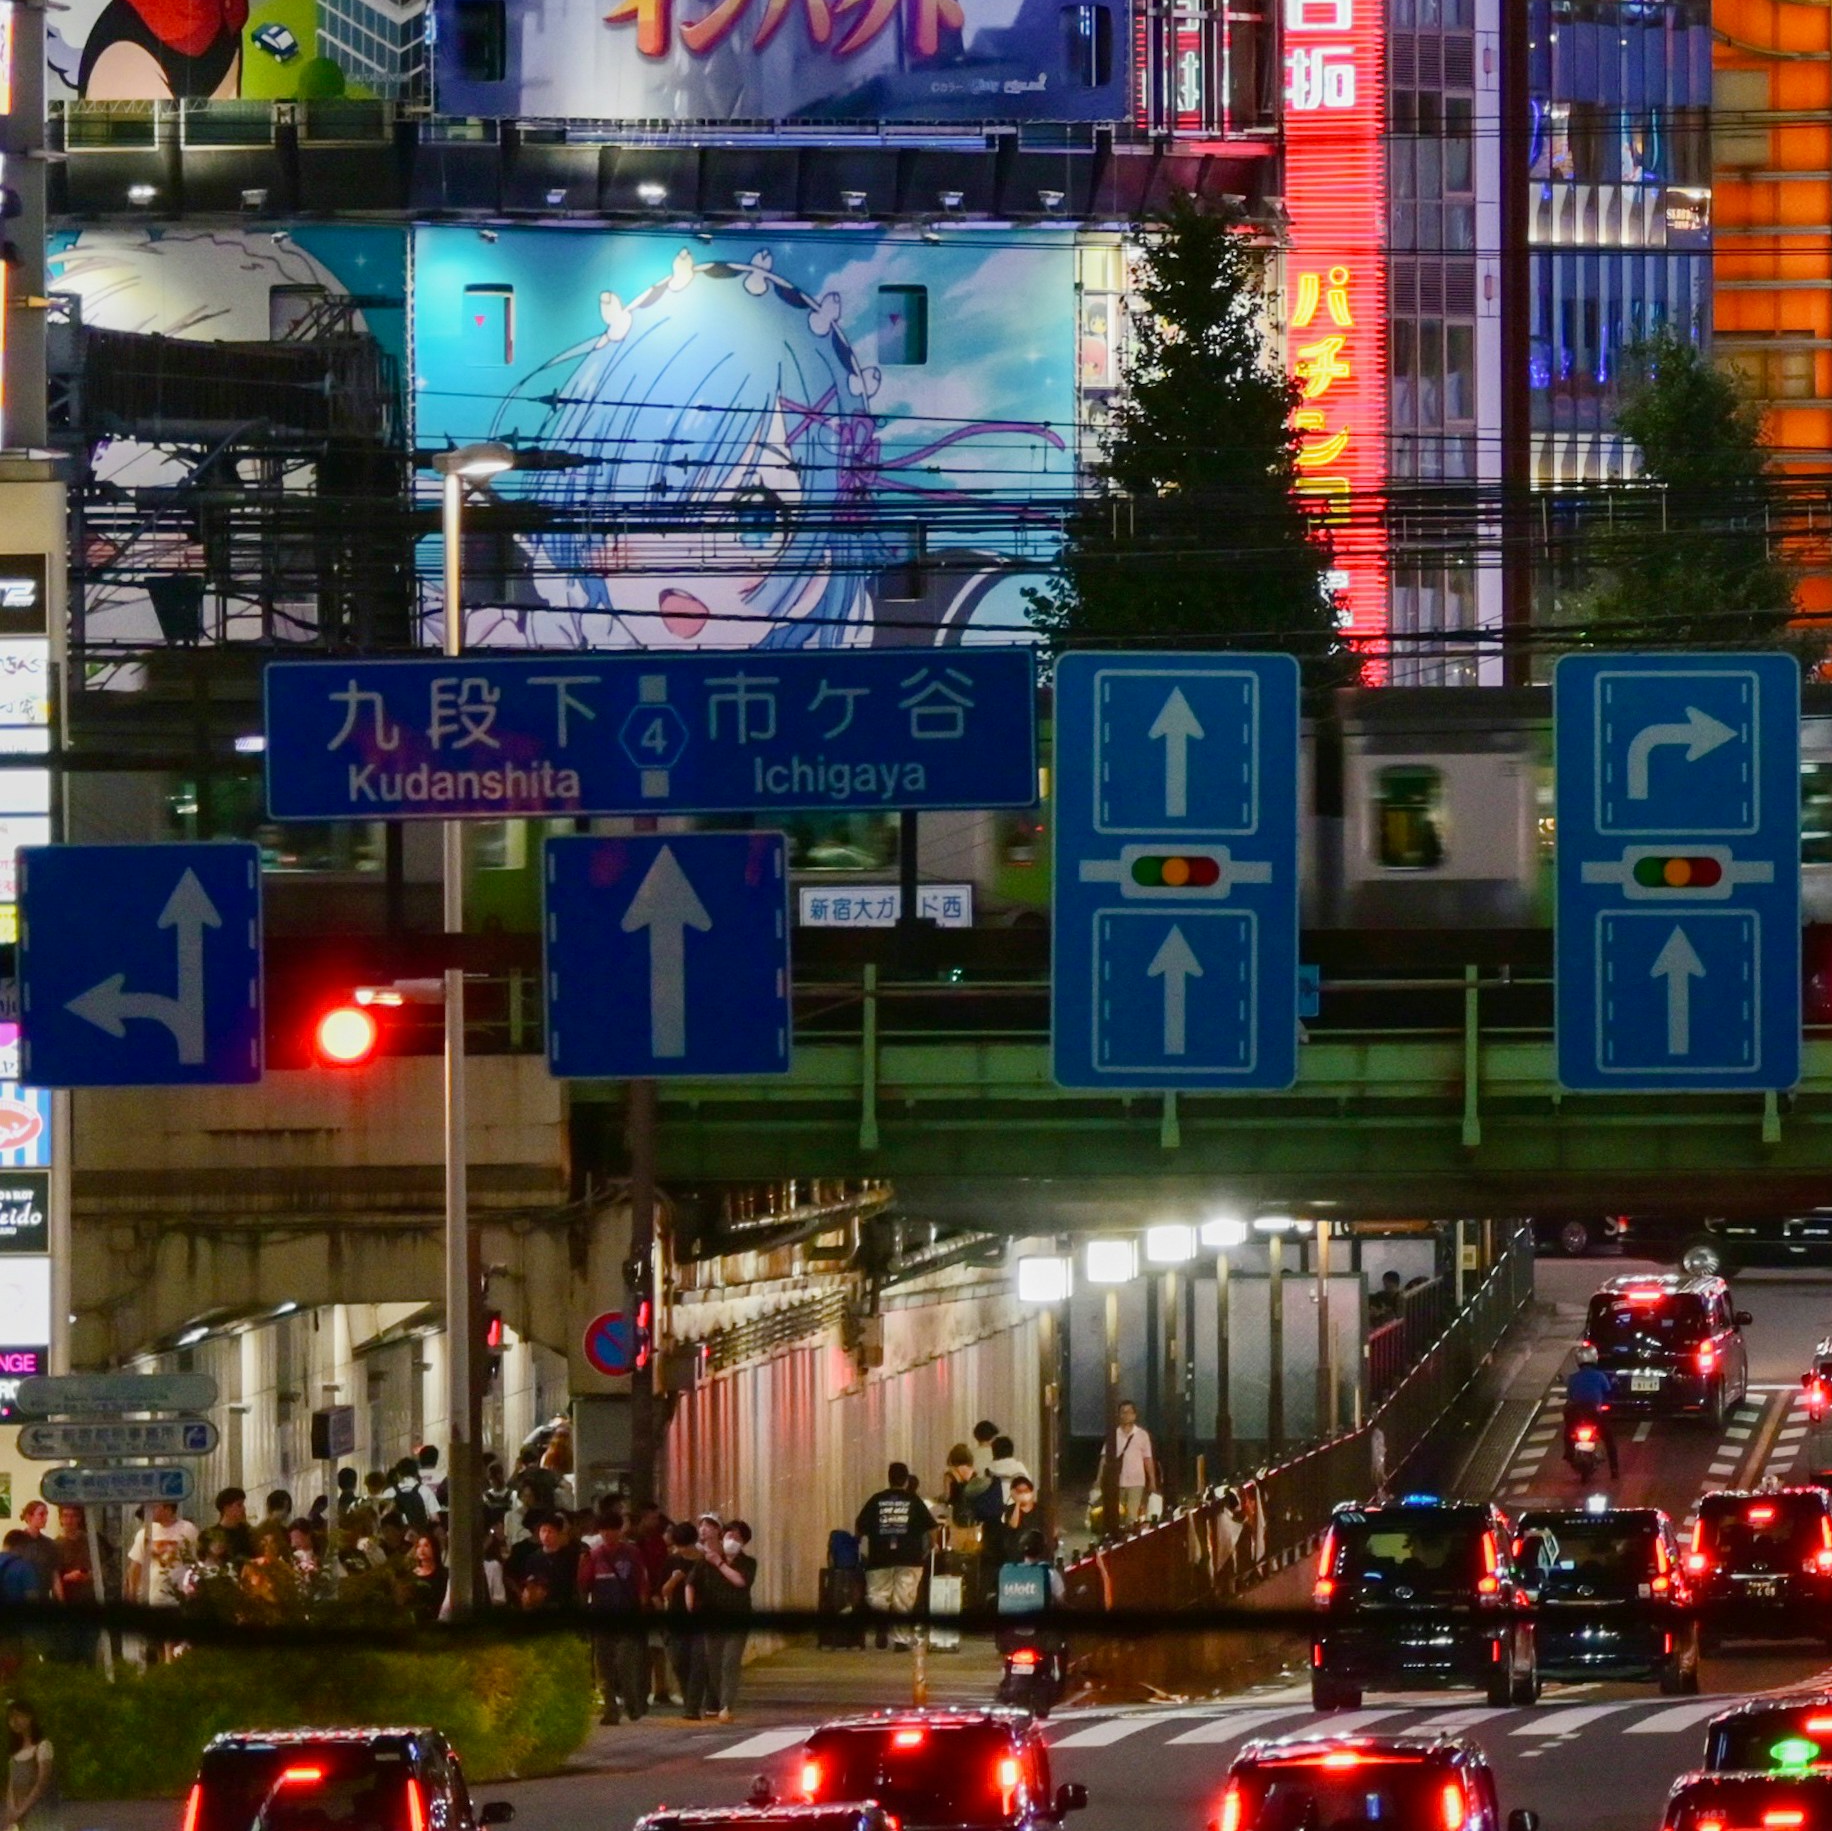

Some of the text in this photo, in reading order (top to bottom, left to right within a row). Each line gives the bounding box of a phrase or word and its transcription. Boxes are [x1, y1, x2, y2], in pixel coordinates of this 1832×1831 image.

[325, 674, 601, 752] 九段下
[640, 717, 669, 756] 4
[347, 762, 582, 803] Kudanshita
[752, 755, 927, 797] Ichigaya
[811, 896, 965, 922] 新宿大ガド西
[1003, 1582, 1038, 1597] Wolt
